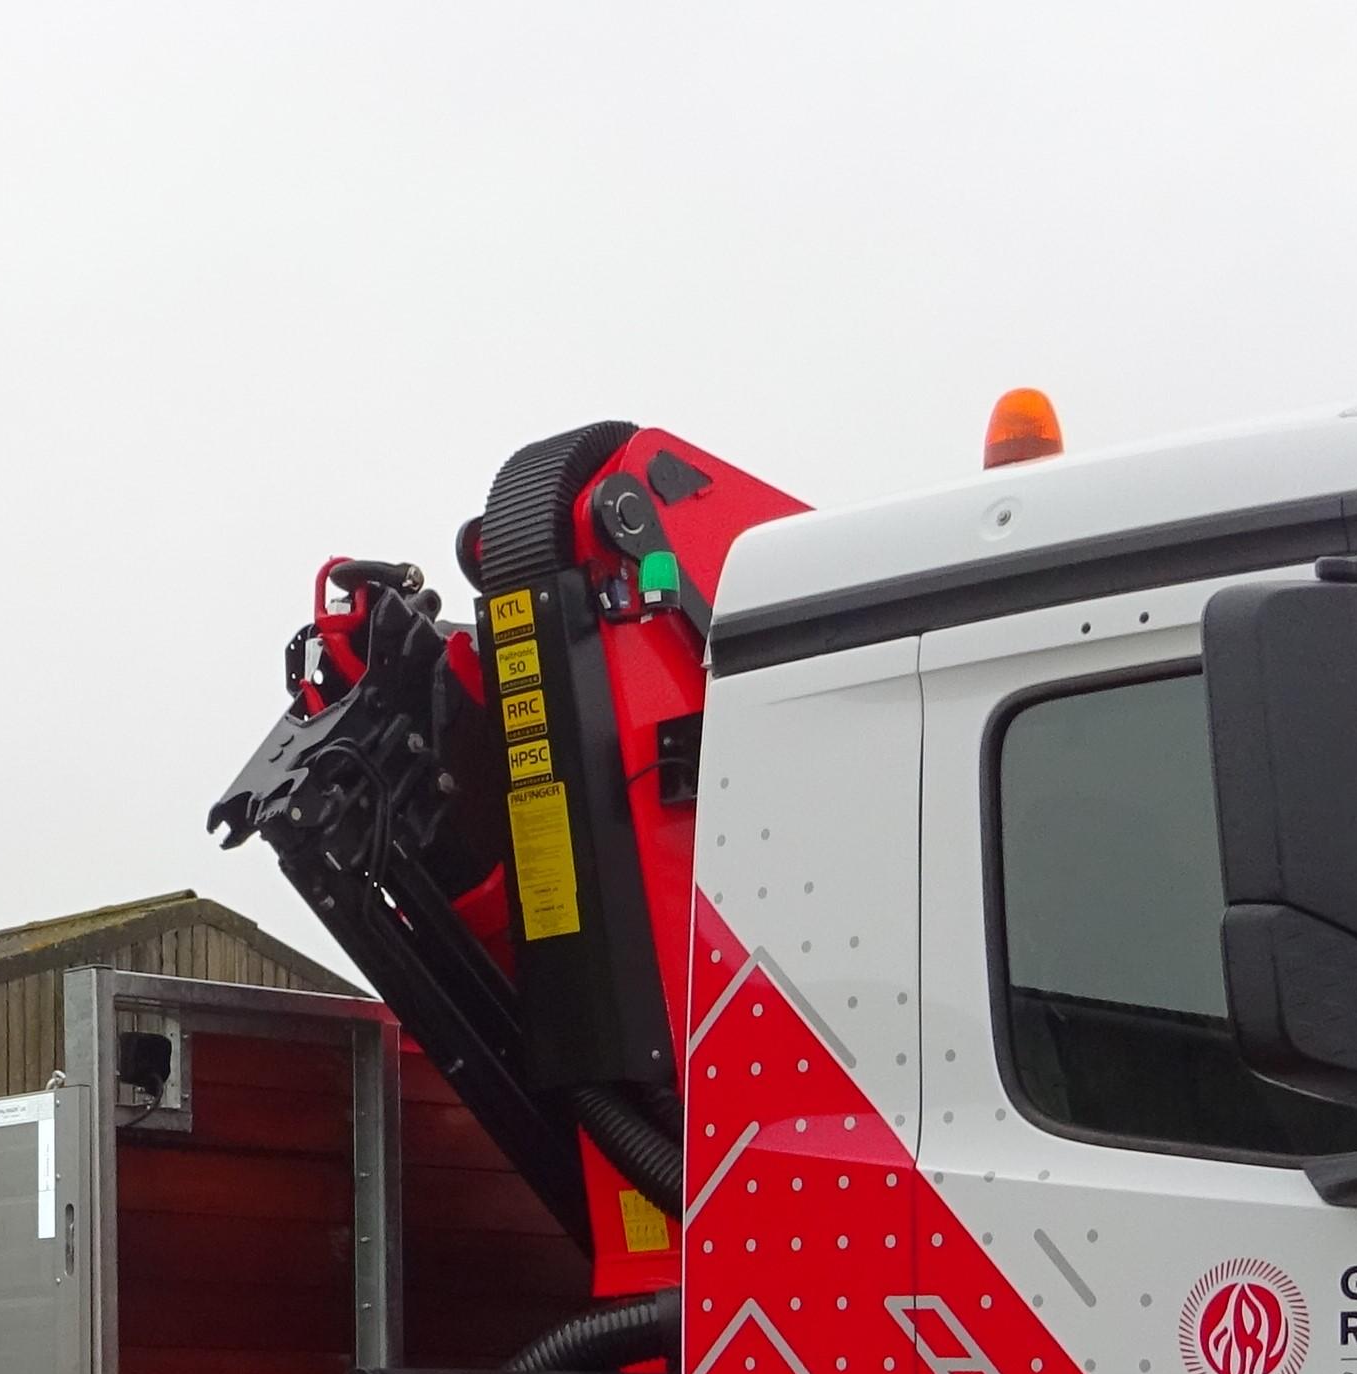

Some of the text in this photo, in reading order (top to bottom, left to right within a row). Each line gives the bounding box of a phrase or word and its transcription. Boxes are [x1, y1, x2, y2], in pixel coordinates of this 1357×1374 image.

[496, 599, 526, 620] KTL
[508, 660, 526, 675] 50
[507, 698, 540, 720] RRC
[510, 746, 548, 769] HPSC
